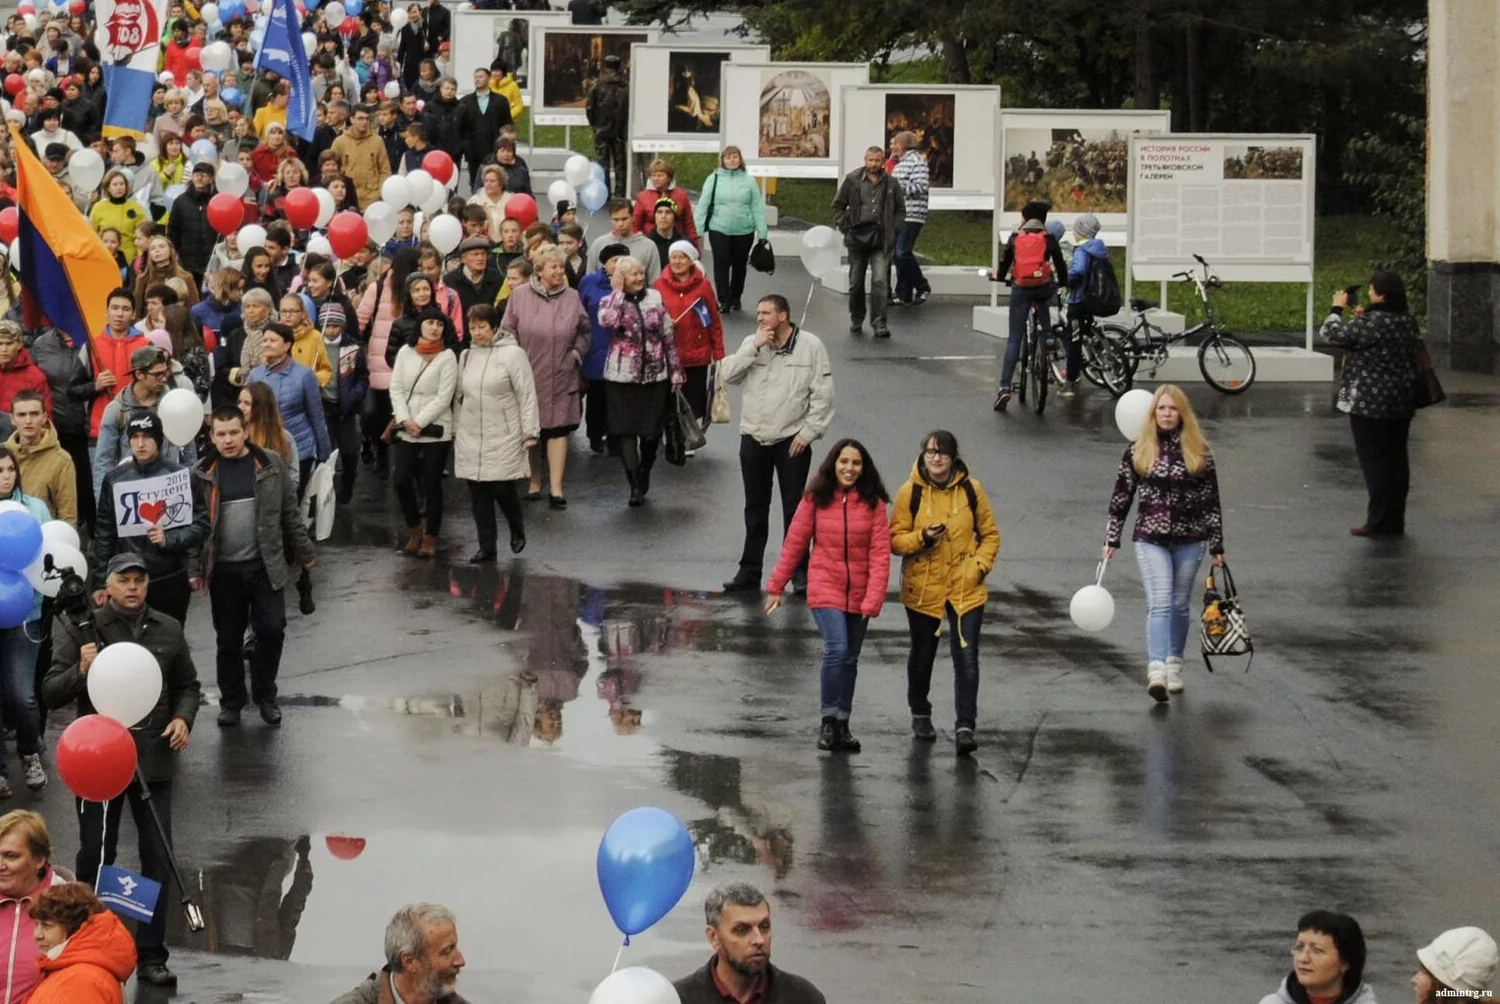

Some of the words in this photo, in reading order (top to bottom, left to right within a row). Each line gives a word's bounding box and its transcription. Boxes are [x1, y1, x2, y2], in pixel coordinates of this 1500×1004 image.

[1140, 145, 1176, 153] ИСТОРИЯ
[1179, 145, 1211, 153] РОССИИ
[166, 472, 188, 486] 2016
[119, 491, 143, 526] Я
[138, 482, 189, 500] студент
